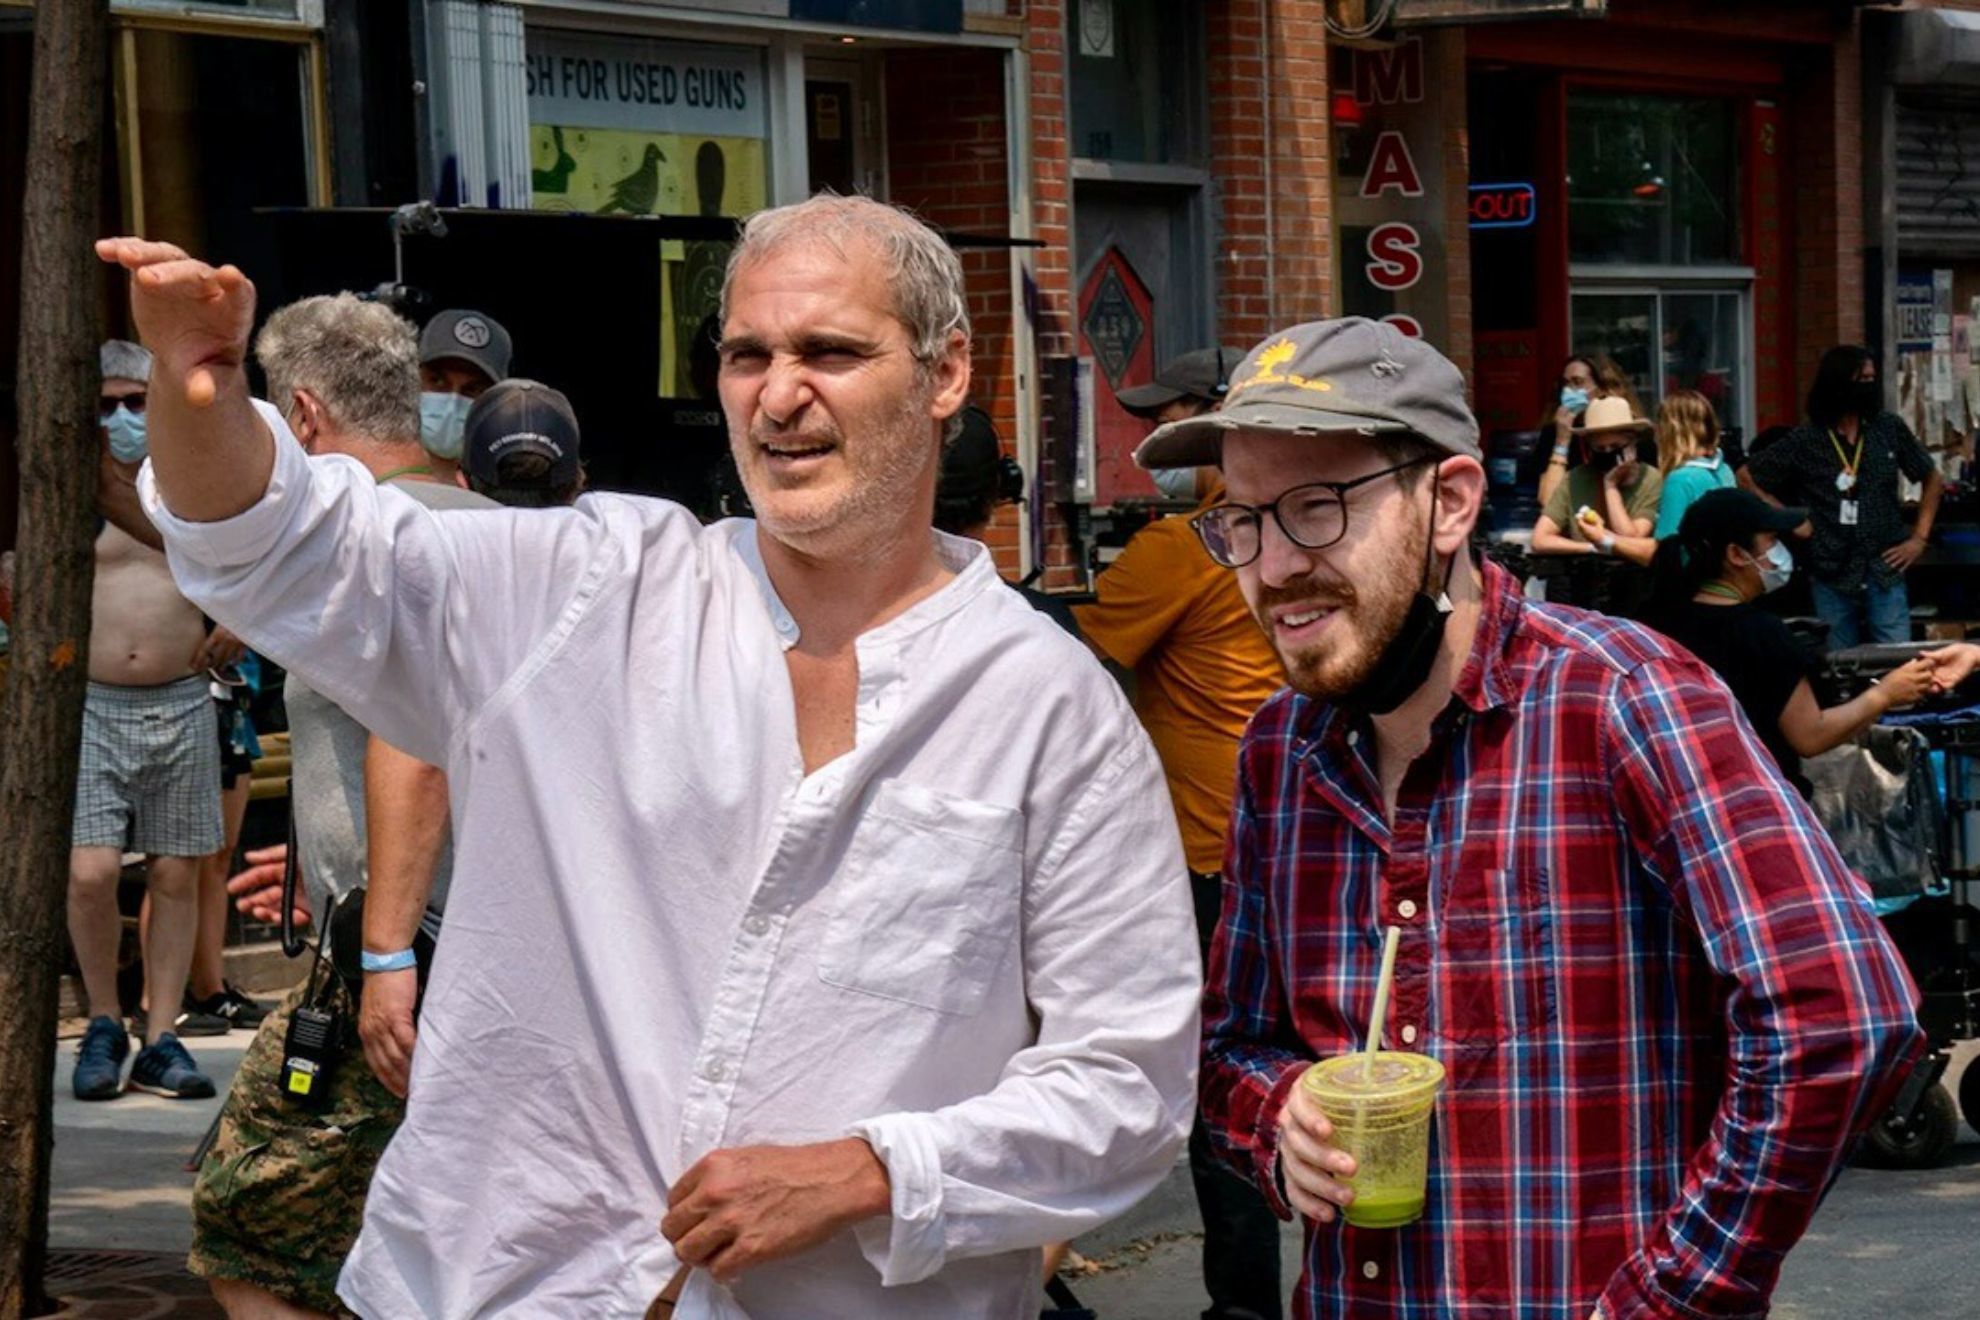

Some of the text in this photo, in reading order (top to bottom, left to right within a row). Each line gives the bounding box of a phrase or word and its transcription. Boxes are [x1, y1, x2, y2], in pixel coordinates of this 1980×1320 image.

[562, 57, 609, 101] FOR
[616, 61, 678, 105] USED
[684, 68, 746, 111] GUNS
